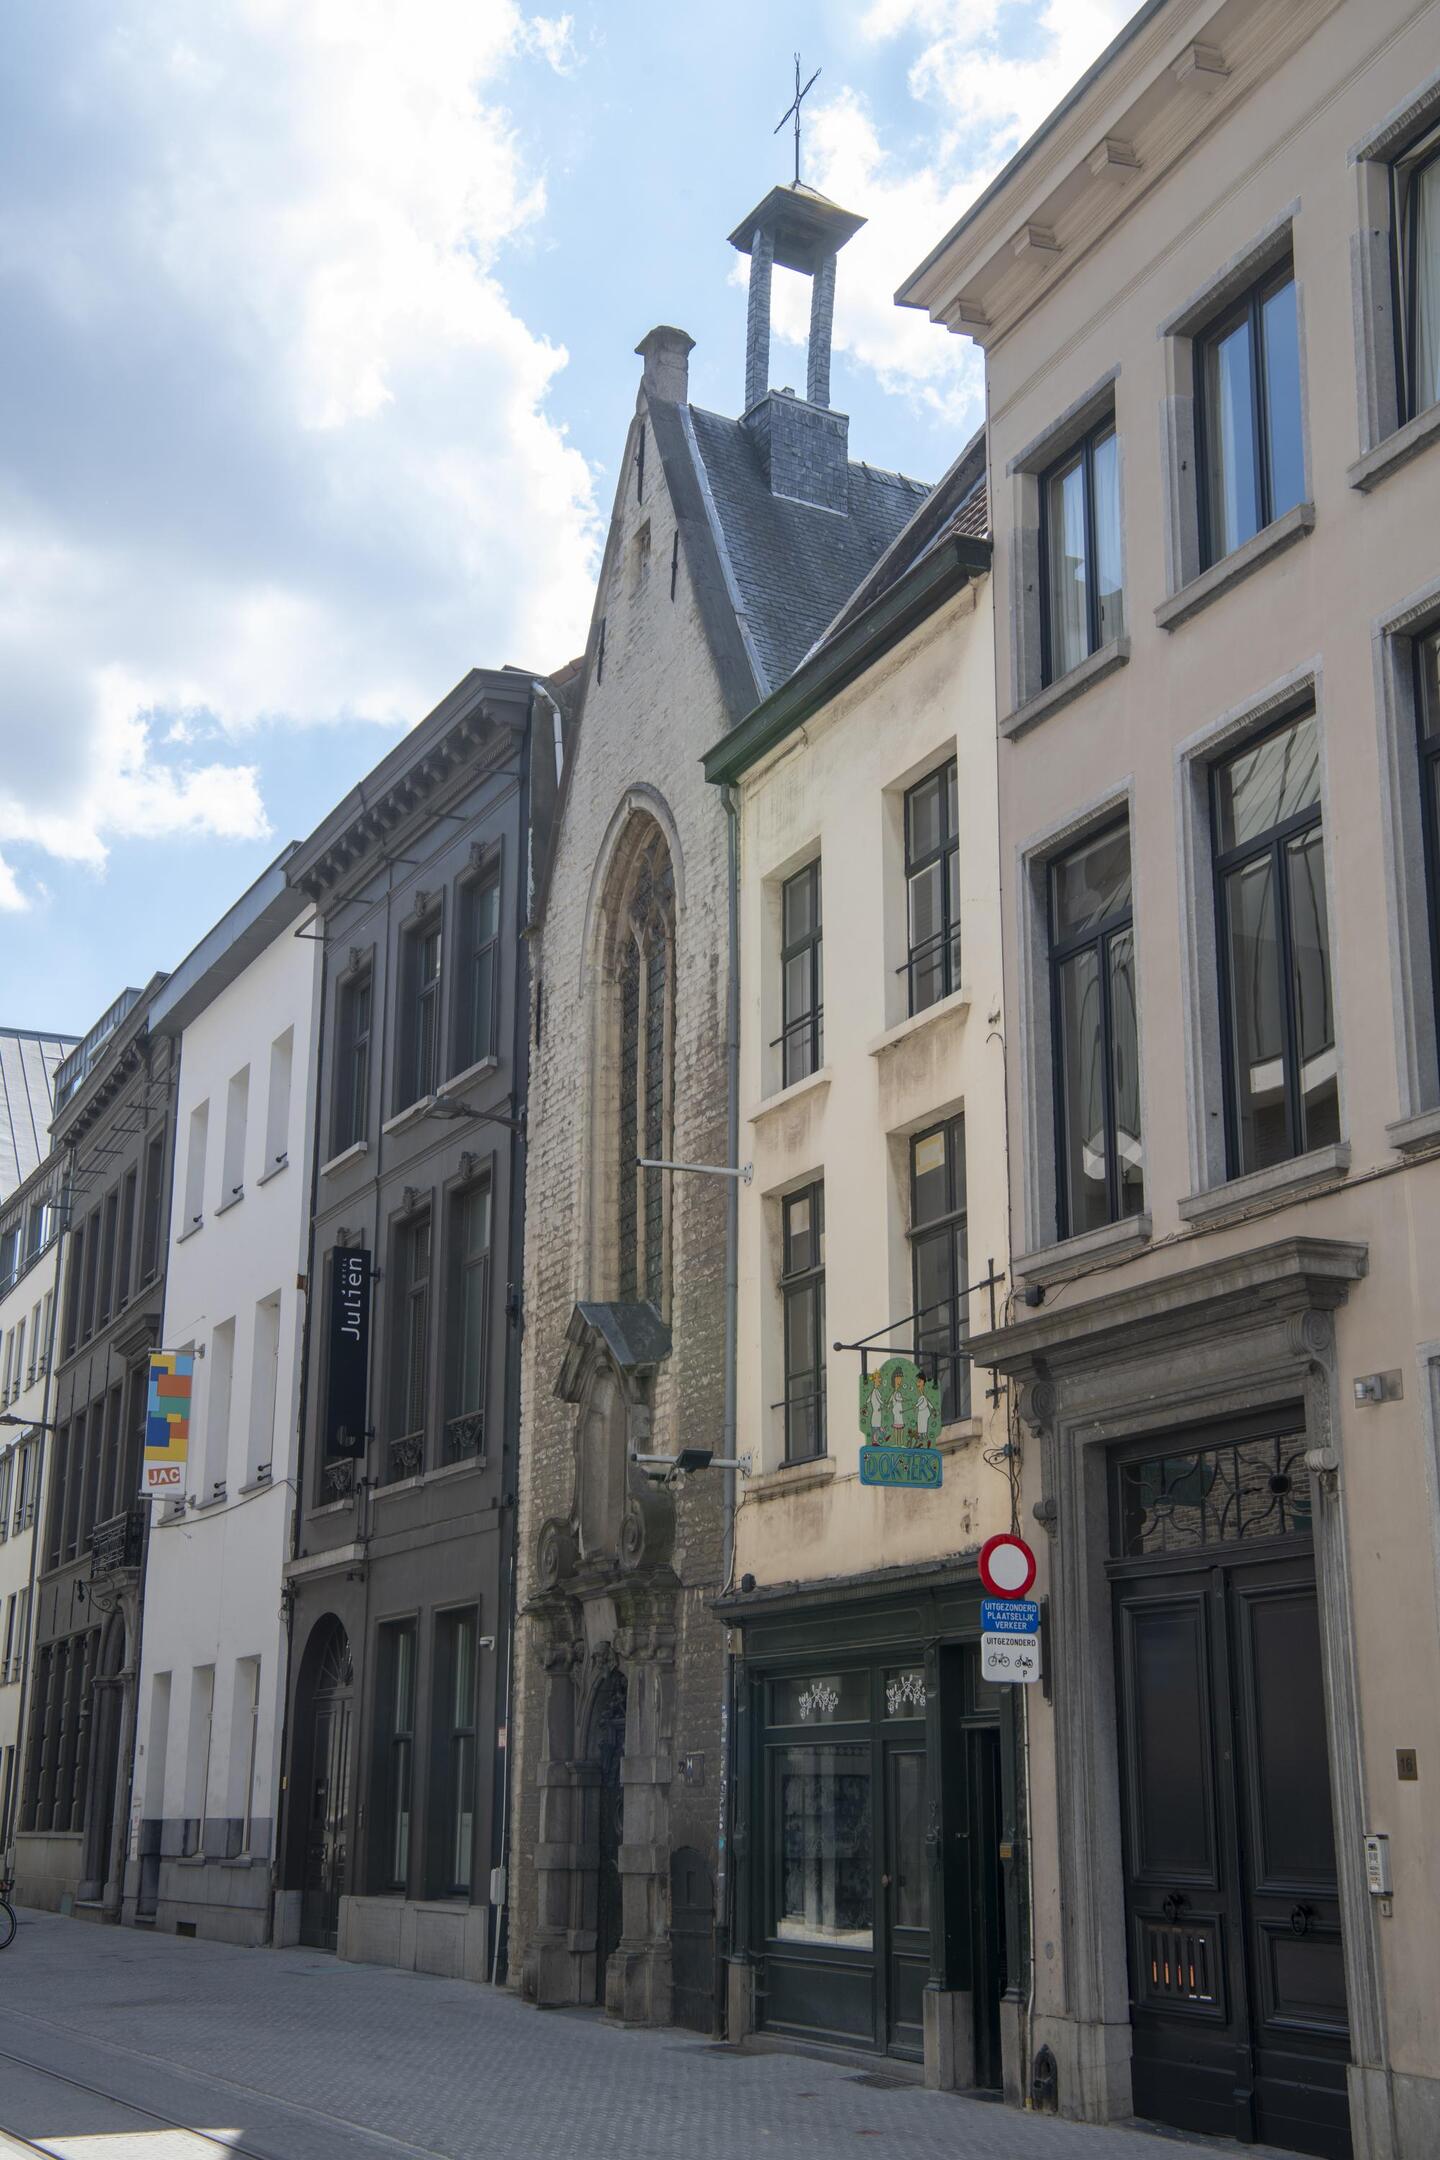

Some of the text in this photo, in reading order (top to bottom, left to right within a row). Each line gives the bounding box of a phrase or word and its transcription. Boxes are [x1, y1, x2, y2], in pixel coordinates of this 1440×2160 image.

[341, 1258, 362, 1340] Julien
[150, 1468, 180, 1484] JAC
[984, 1602, 1037, 1612] UITGEZONDERD
[987, 1611, 1034, 1621] PLAATSELIJK
[995, 1620, 1027, 1630] VERKEER
[986, 1637, 1036, 1647] UITGEZONDERD
[1022, 1669, 1028, 1678] P
